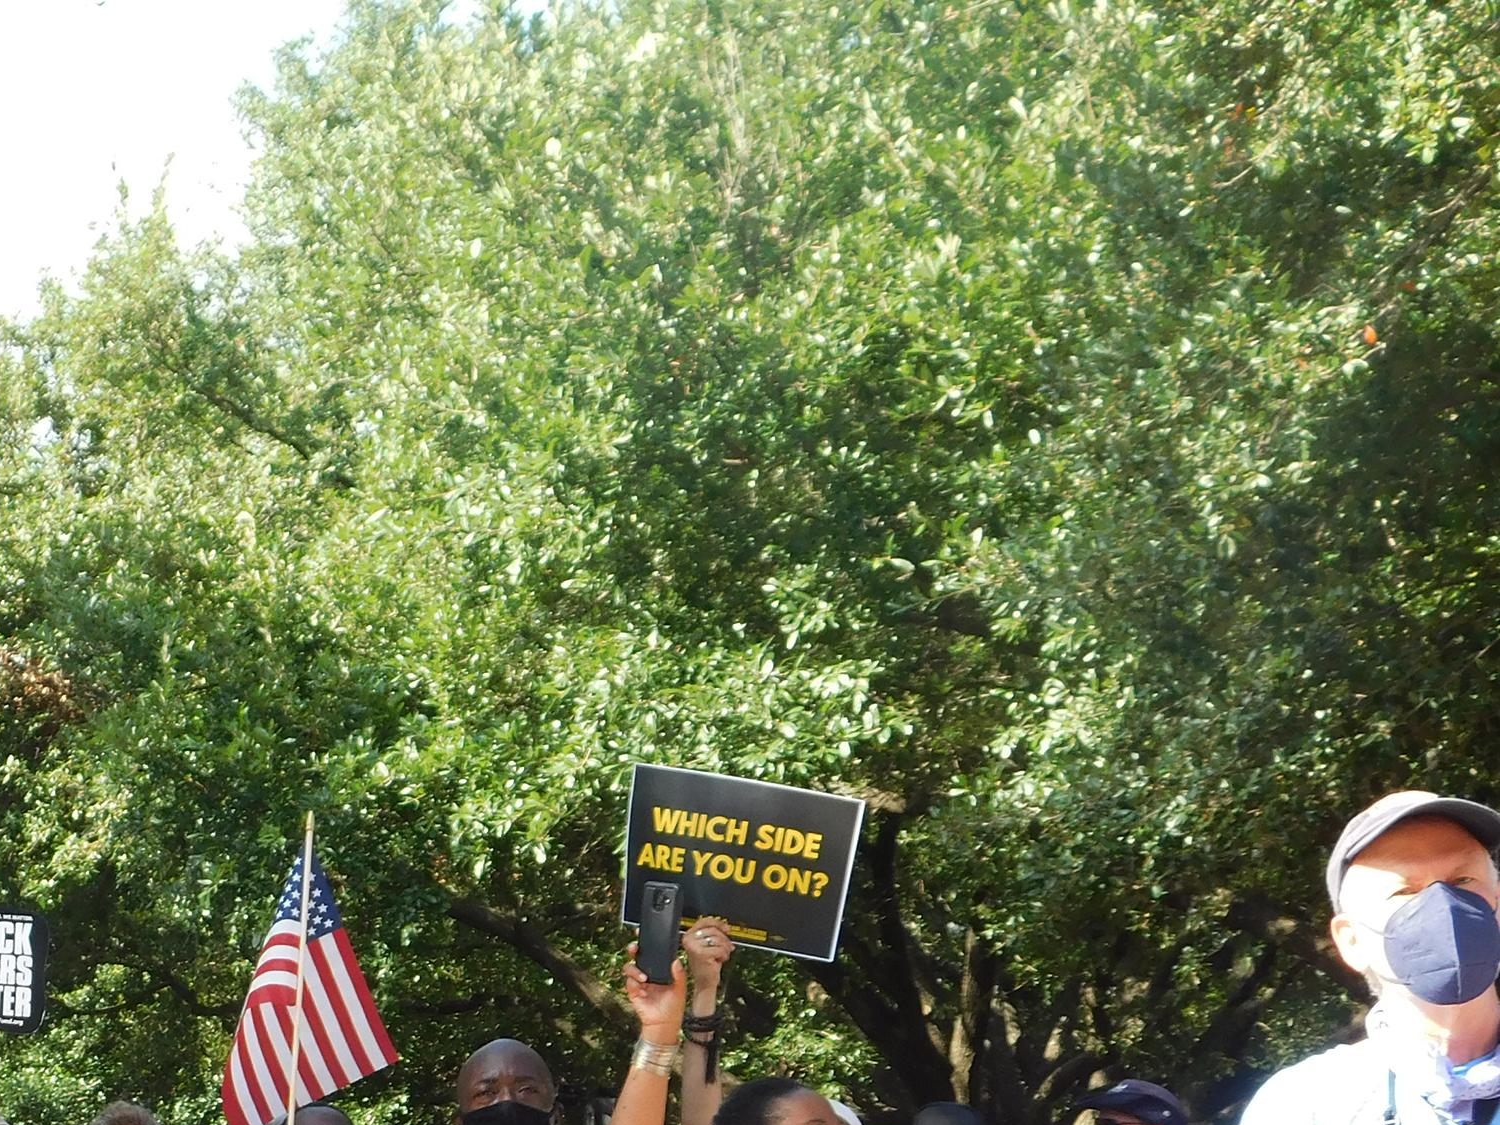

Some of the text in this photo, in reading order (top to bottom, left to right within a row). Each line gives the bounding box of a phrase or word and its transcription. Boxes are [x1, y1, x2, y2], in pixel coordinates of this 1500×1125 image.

[653, 806, 823, 859] WHICH SIDE
[637, 842, 829, 898] ARE YOU ON?
